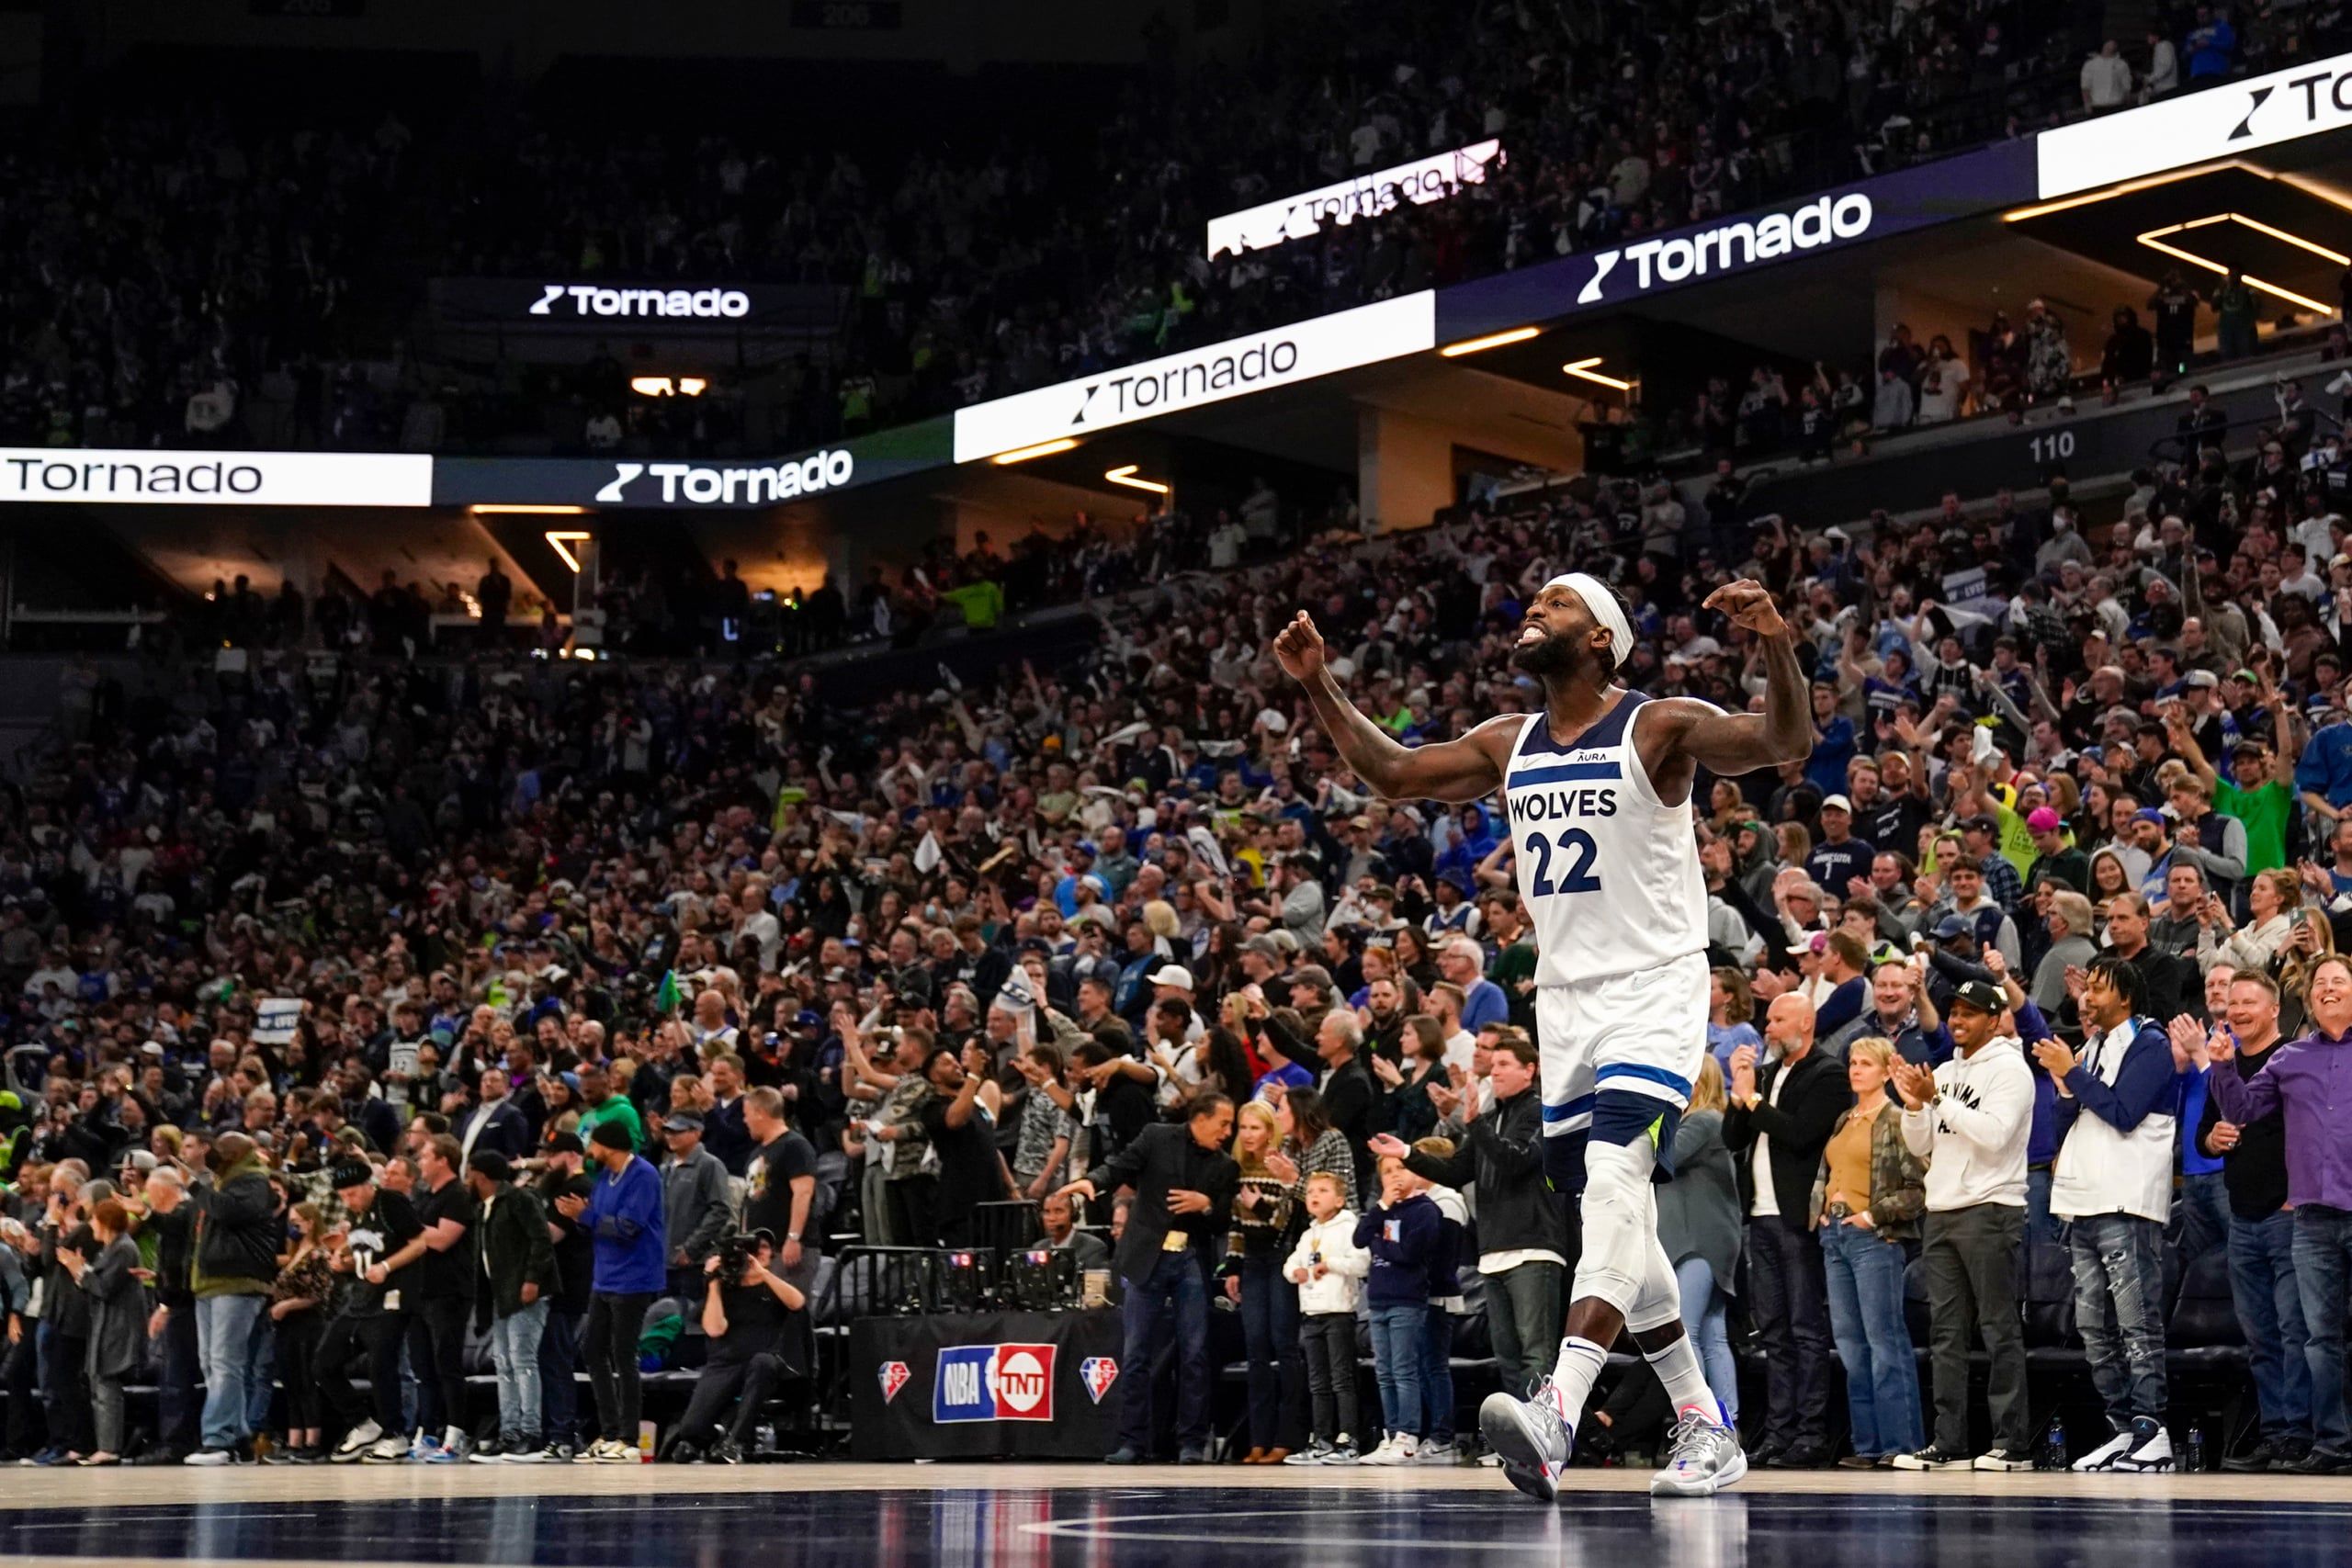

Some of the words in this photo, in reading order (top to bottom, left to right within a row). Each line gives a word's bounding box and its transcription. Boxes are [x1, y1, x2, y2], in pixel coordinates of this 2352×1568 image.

[1305, 168, 1442, 220] Tornado
[1624, 192, 1872, 289] Tornado
[567, 285, 750, 318] Tornado
[1109, 341, 1297, 413] Tornado
[2029, 431, 2075, 463] 110
[6, 458, 263, 493] Tornado
[649, 449, 854, 504] Tornado
[1510, 788, 1617, 824] WOLVES
[1525, 827, 1601, 897] 22
[944, 1362, 980, 1405] NBA
[1000, 1373, 1045, 1396] TNT
